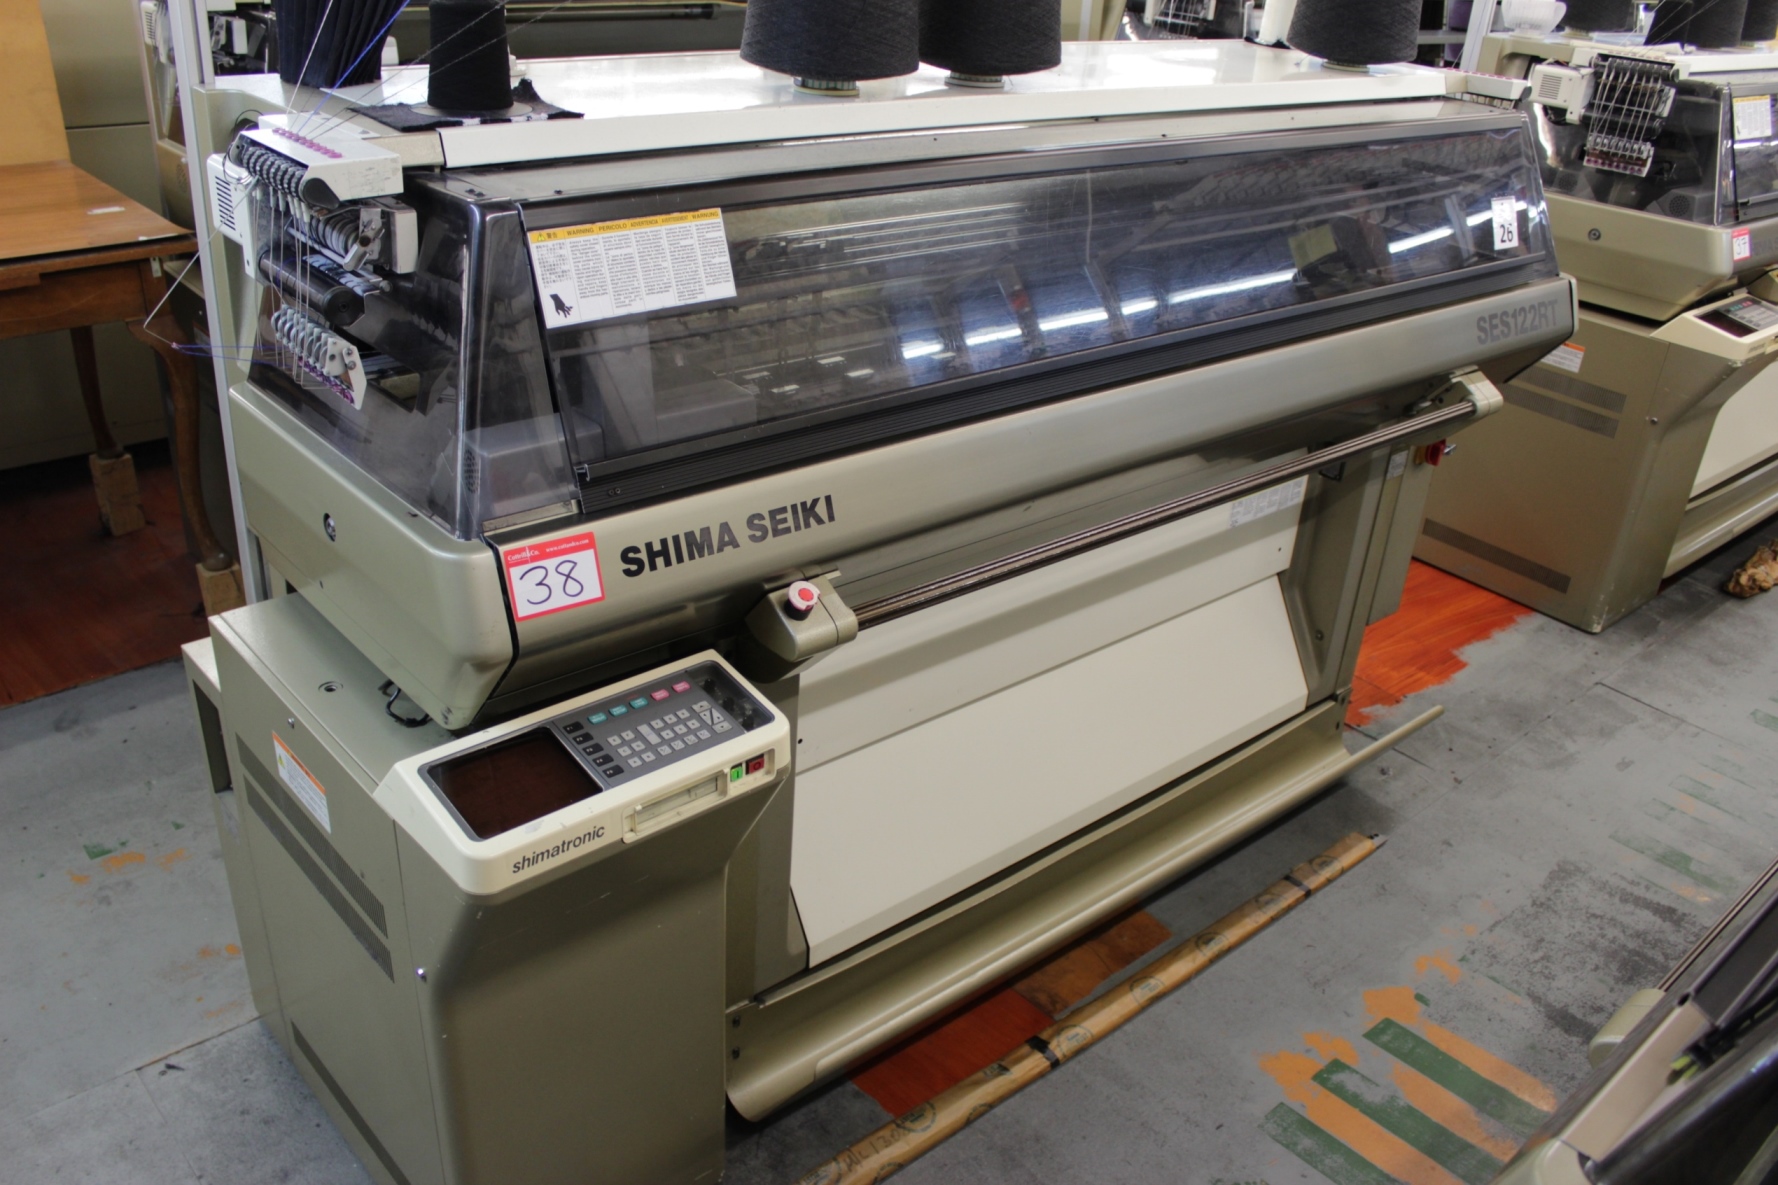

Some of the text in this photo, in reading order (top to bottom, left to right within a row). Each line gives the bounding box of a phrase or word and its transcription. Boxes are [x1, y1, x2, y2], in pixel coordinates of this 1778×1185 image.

[566, 227, 595, 236] WARNING
[598, 222, 628, 232] PERICOLO
[691, 211, 719, 220] WARNUNG
[1500, 223, 1514, 243] 26
[1476, 299, 1559, 345] SES122RT
[620, 494, 836, 578] SHIMA SEIKI
[519, 560, 585, 605] 38
[512, 826, 605, 874] shimatronic
